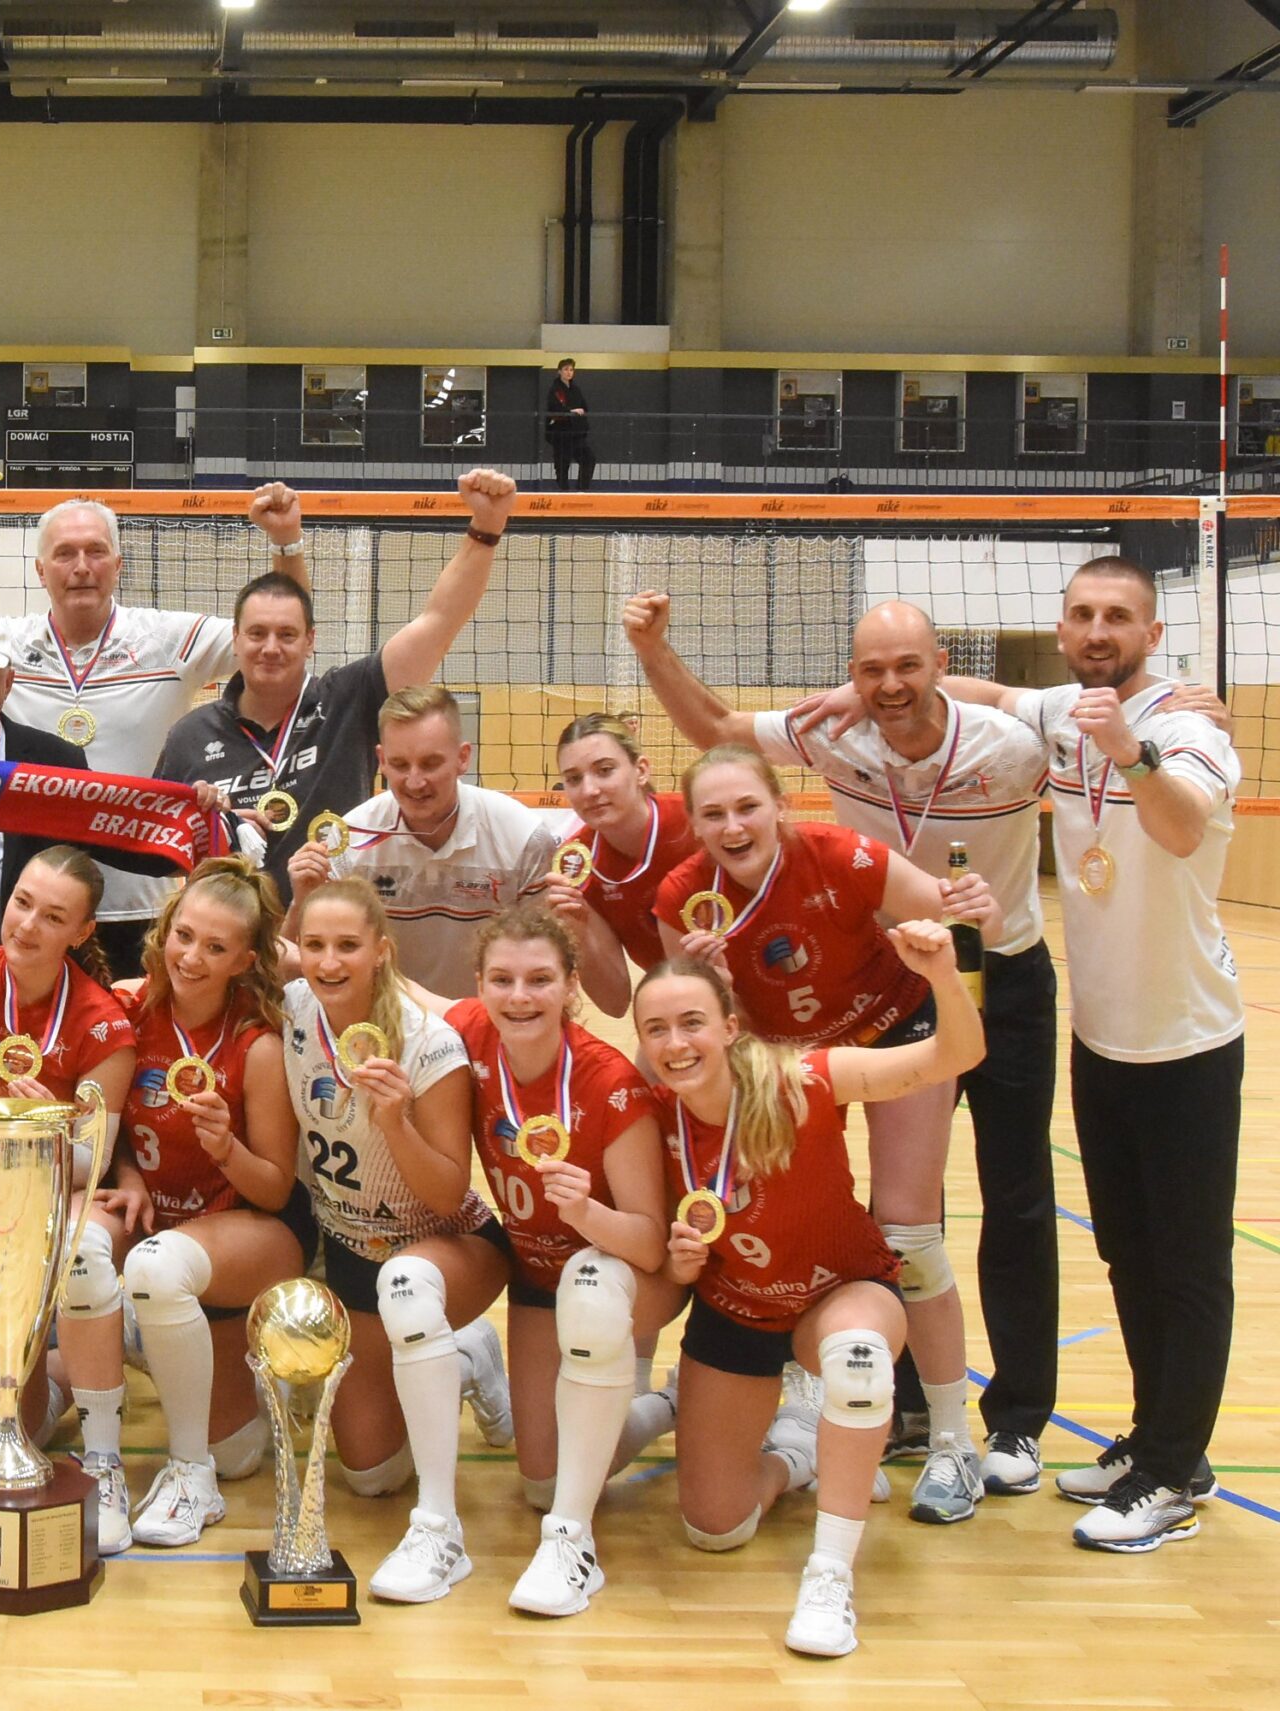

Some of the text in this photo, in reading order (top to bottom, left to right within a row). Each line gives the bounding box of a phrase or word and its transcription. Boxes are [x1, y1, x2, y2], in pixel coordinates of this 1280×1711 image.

[7, 409, 29, 418] LGR
[10, 431, 130, 441] DOMÁCI HOSTIA
[182, 496, 205, 508] niké
[413, 497, 436, 510] niké
[529, 498, 552, 510] niké
[646, 499, 668, 511] niké
[761, 499, 784, 512] niké
[877, 500, 900, 513] niké
[1108, 501, 1131, 513] niké
[538, 794, 561, 806] niké
[787, 985, 822, 1023] 5
[135, 1124, 161, 1171] 3
[308, 1130, 362, 1191] 22
[489, 1165, 535, 1220] 10
[729, 1232, 771, 1268] 9
[70, 1268, 88, 1277] rrea
[574, 1278, 598, 1287] errea
[391, 1288, 414, 1300] errea
[846, 1359, 873, 1368] errea
